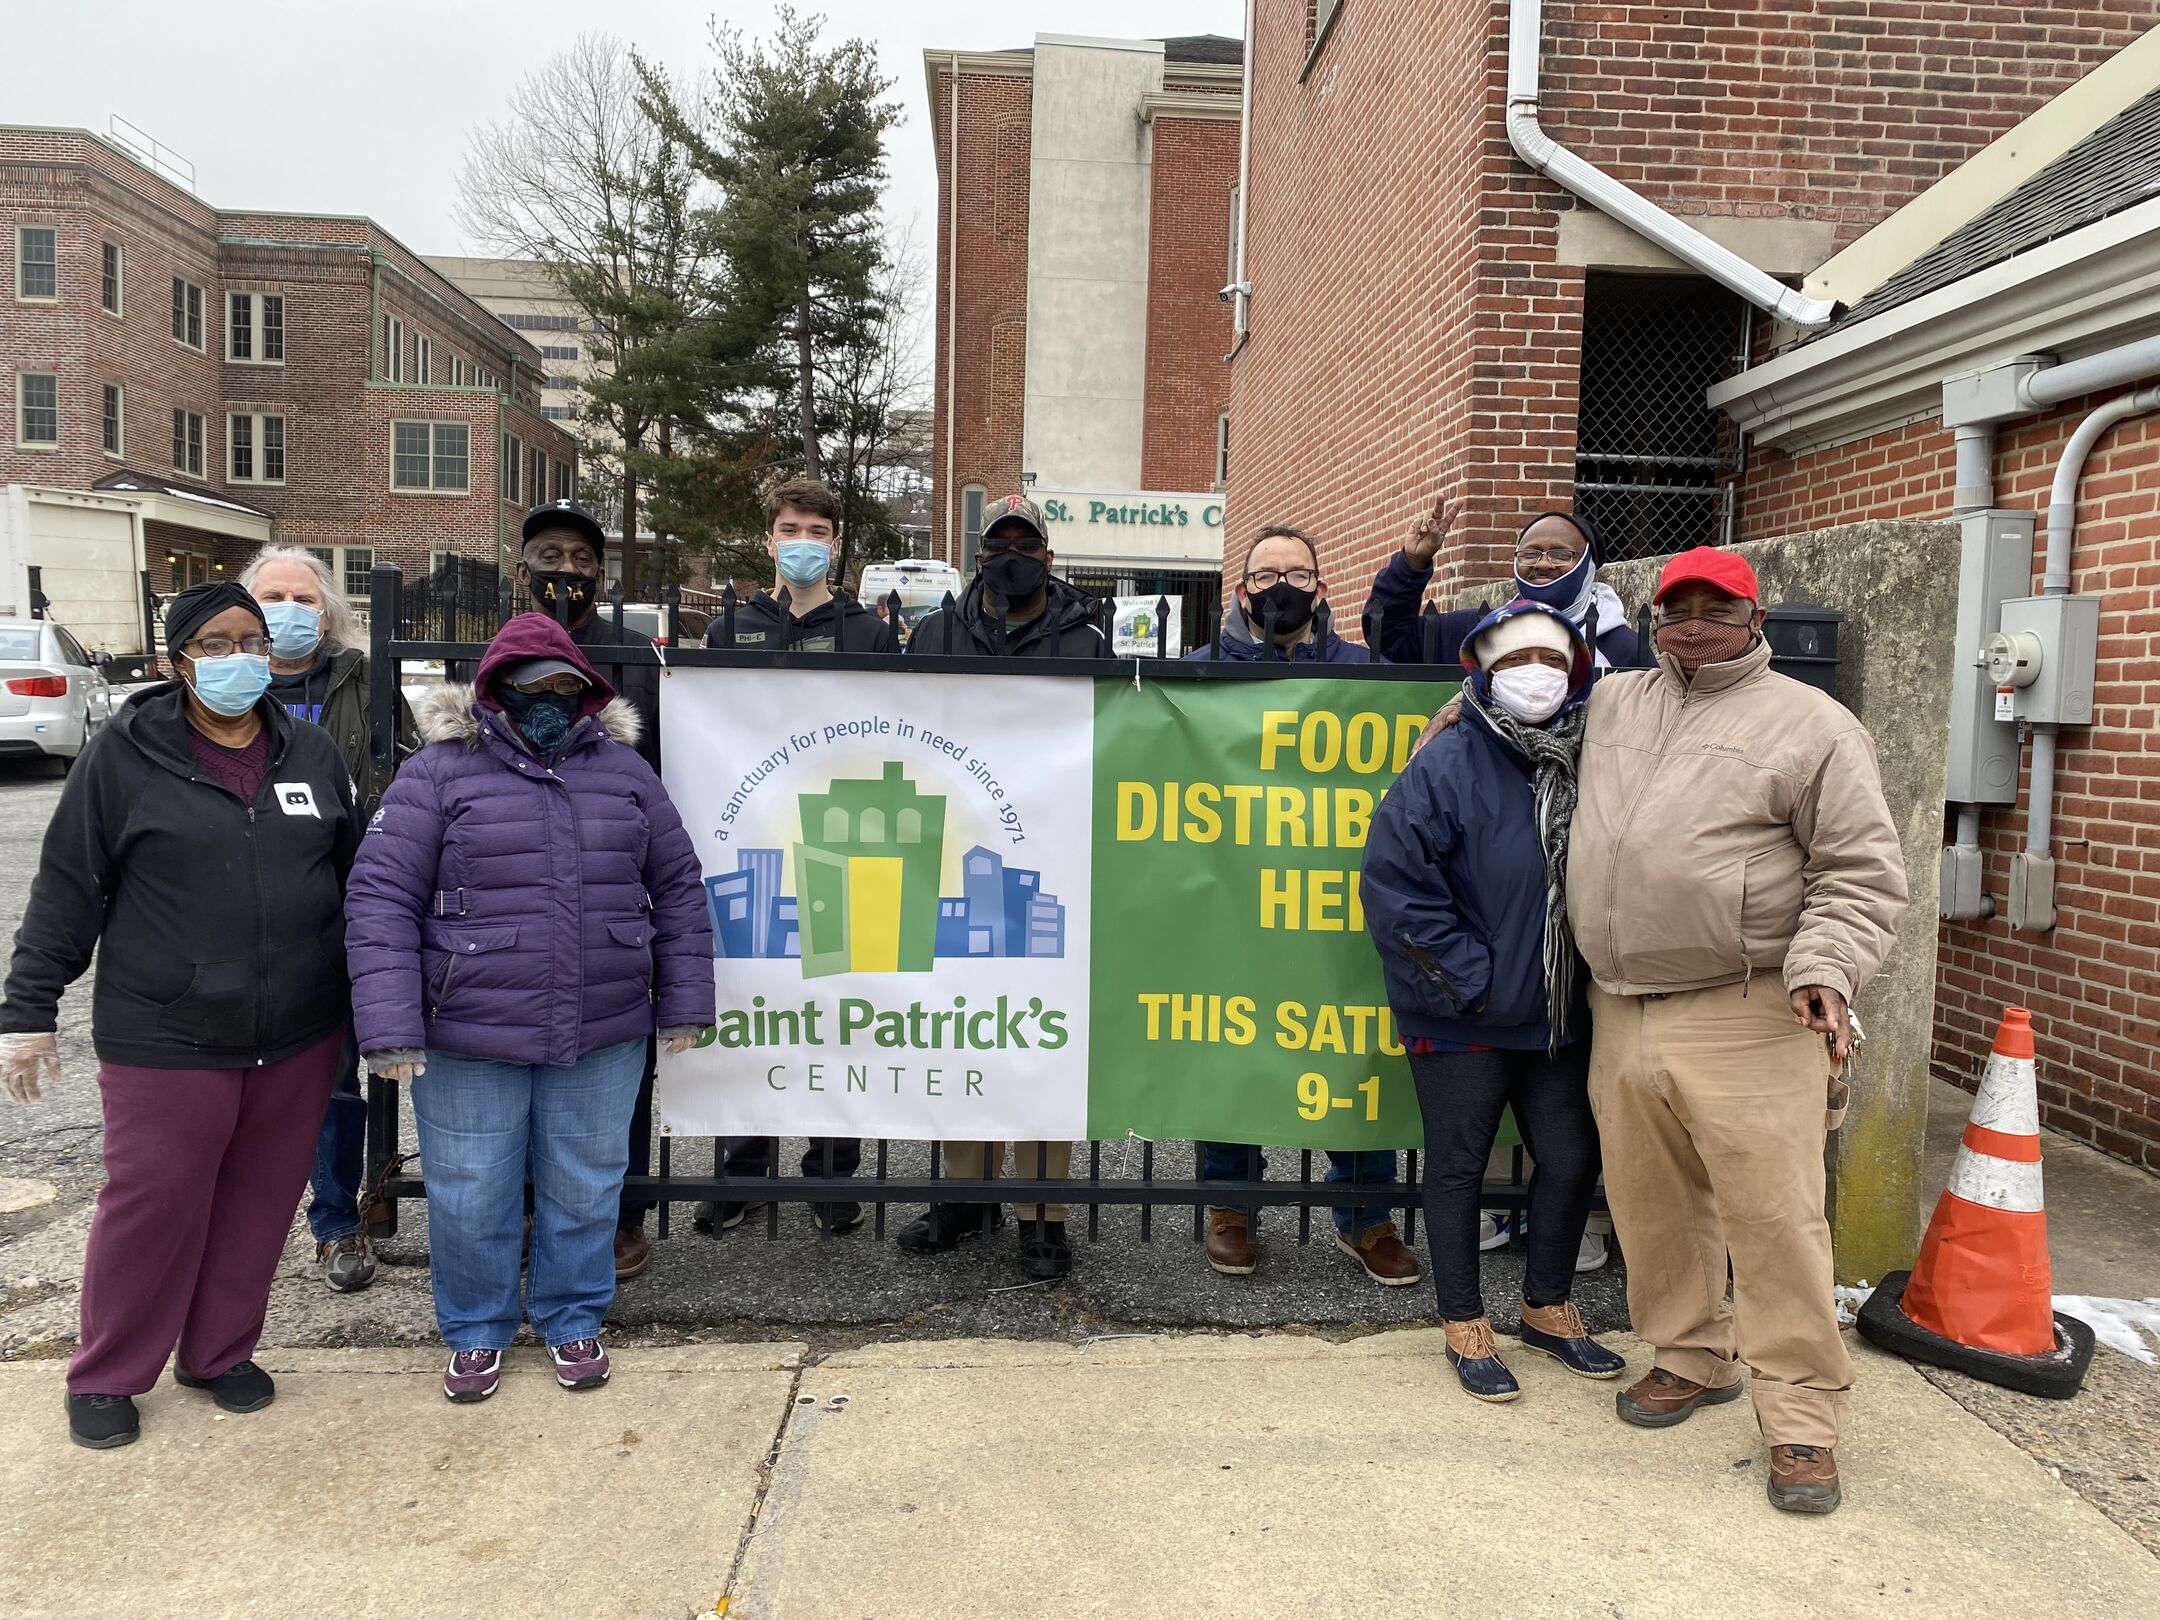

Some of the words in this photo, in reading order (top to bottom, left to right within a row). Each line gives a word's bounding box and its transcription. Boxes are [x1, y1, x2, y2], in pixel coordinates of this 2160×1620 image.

[1045, 499, 1074, 522] St.
[1088, 500, 1189, 526] Patrick's
[1202, 504, 1226, 527] C
[1131, 640, 1158, 648] Patrick'
[790, 730, 817, 752] for
[823, 715, 890, 744] people
[897, 718, 914, 738] in
[920, 730, 968, 761] need
[1260, 710, 1429, 774] FOOD
[721, 746, 790, 824] sanctuary
[965, 759, 1005, 800] since
[1000, 803, 1025, 844] 1971
[1116, 781, 1388, 848] DISTRIB
[715, 829, 729, 841] a
[839, 995, 1068, 1050] Patrick's
[1138, 993, 1256, 1045] THIS
[767, 1063, 984, 1097] CENTER
[1297, 1072, 1381, 1121] 9-1
